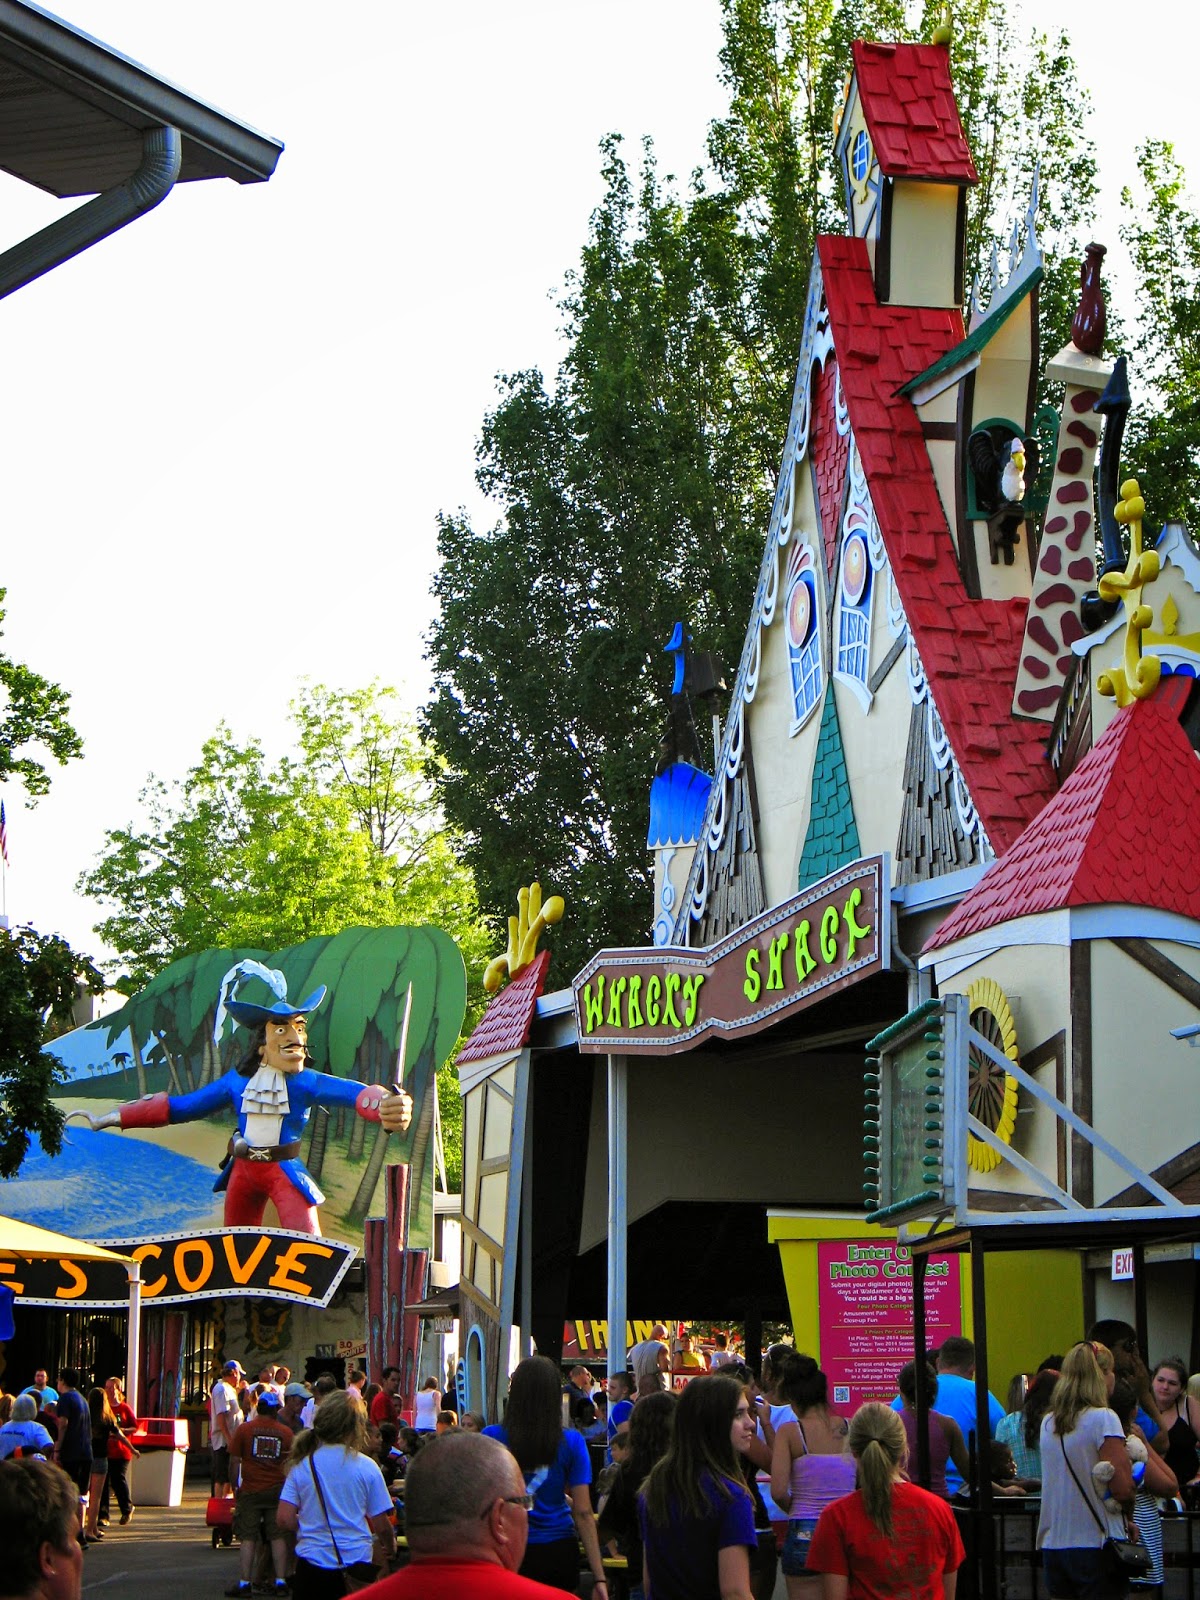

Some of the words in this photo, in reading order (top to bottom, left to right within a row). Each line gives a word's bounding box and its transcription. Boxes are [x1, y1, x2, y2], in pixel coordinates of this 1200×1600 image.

[584, 972, 705, 1034] WHACKY
[743, 887, 872, 1003] SHACK
[847, 1245, 892, 1262] Enter
[131, 1234, 334, 1297] COVE
[830, 1262, 879, 1279] Photo
[882, 1261, 949, 1278] Coest
[895, 1294, 906, 1302] big
